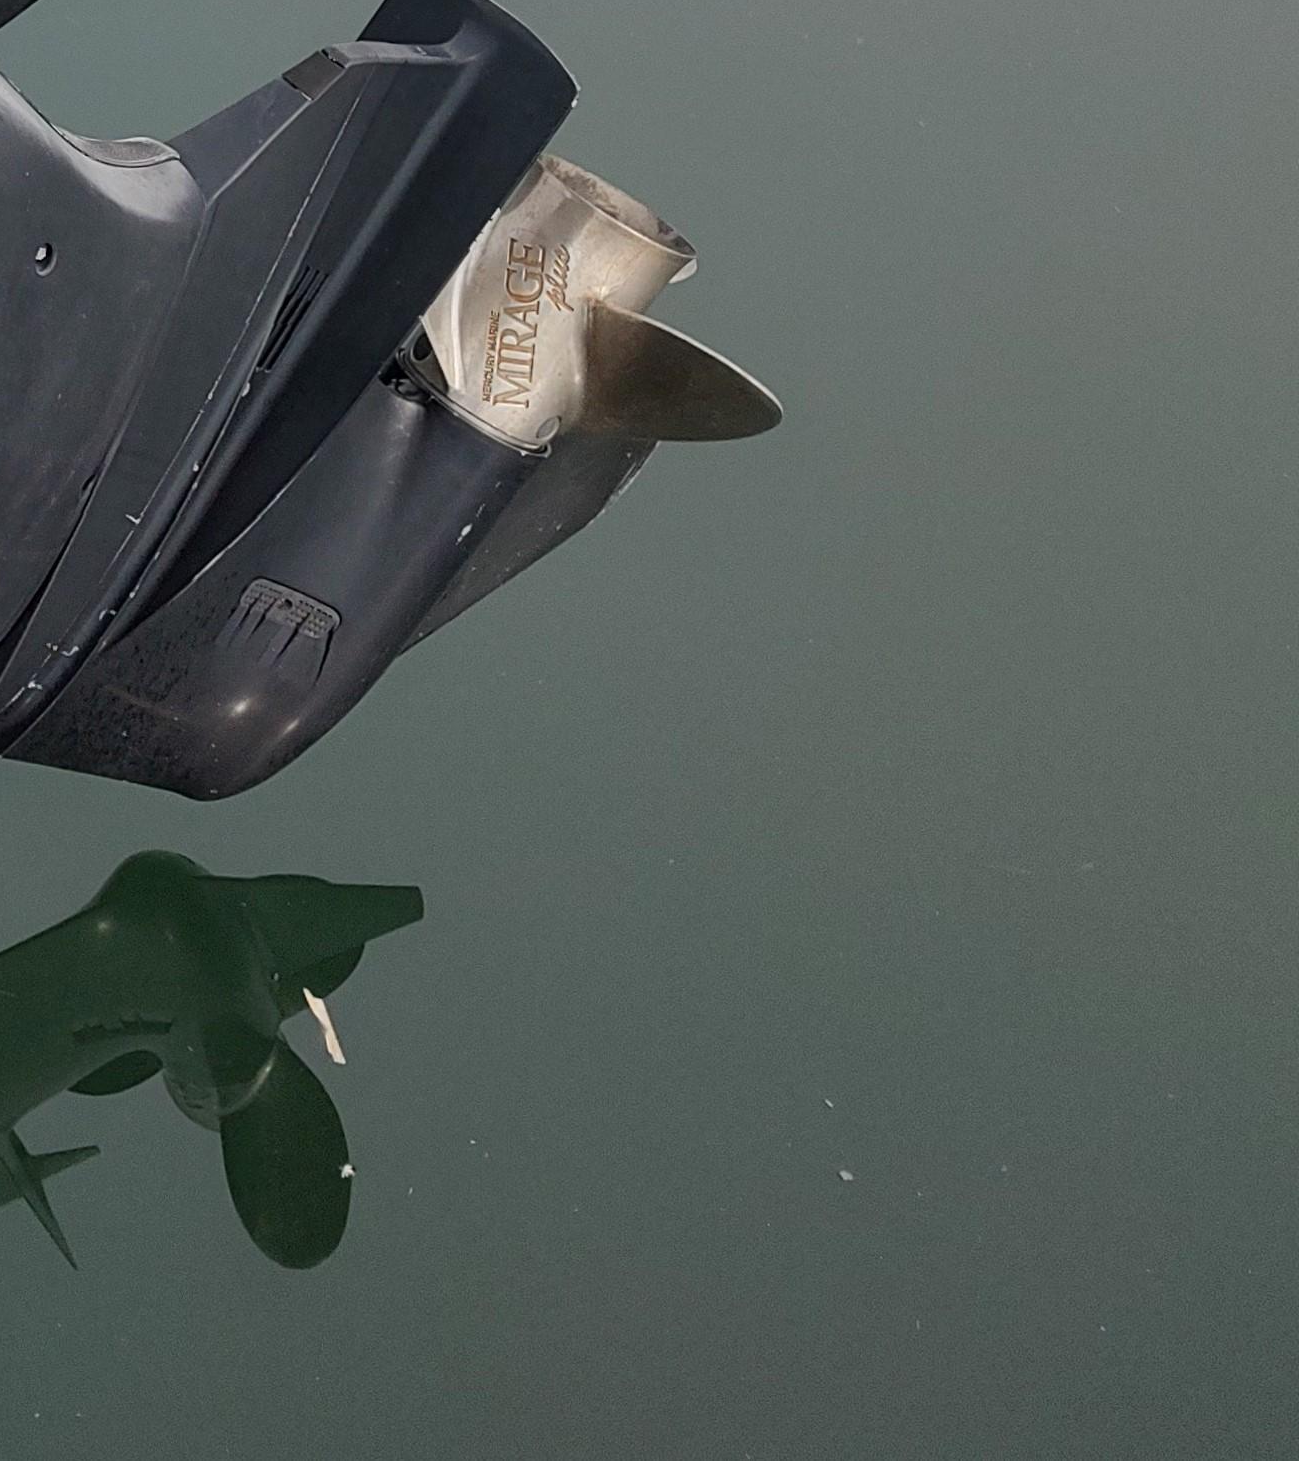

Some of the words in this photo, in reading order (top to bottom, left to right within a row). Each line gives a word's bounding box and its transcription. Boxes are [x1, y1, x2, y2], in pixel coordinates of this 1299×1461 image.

[544, 243, 575, 312] plus
[488, 310, 500, 353] MARINE
[491, 237, 546, 409] MIRAGE
[482, 353, 496, 403] MERCURY
